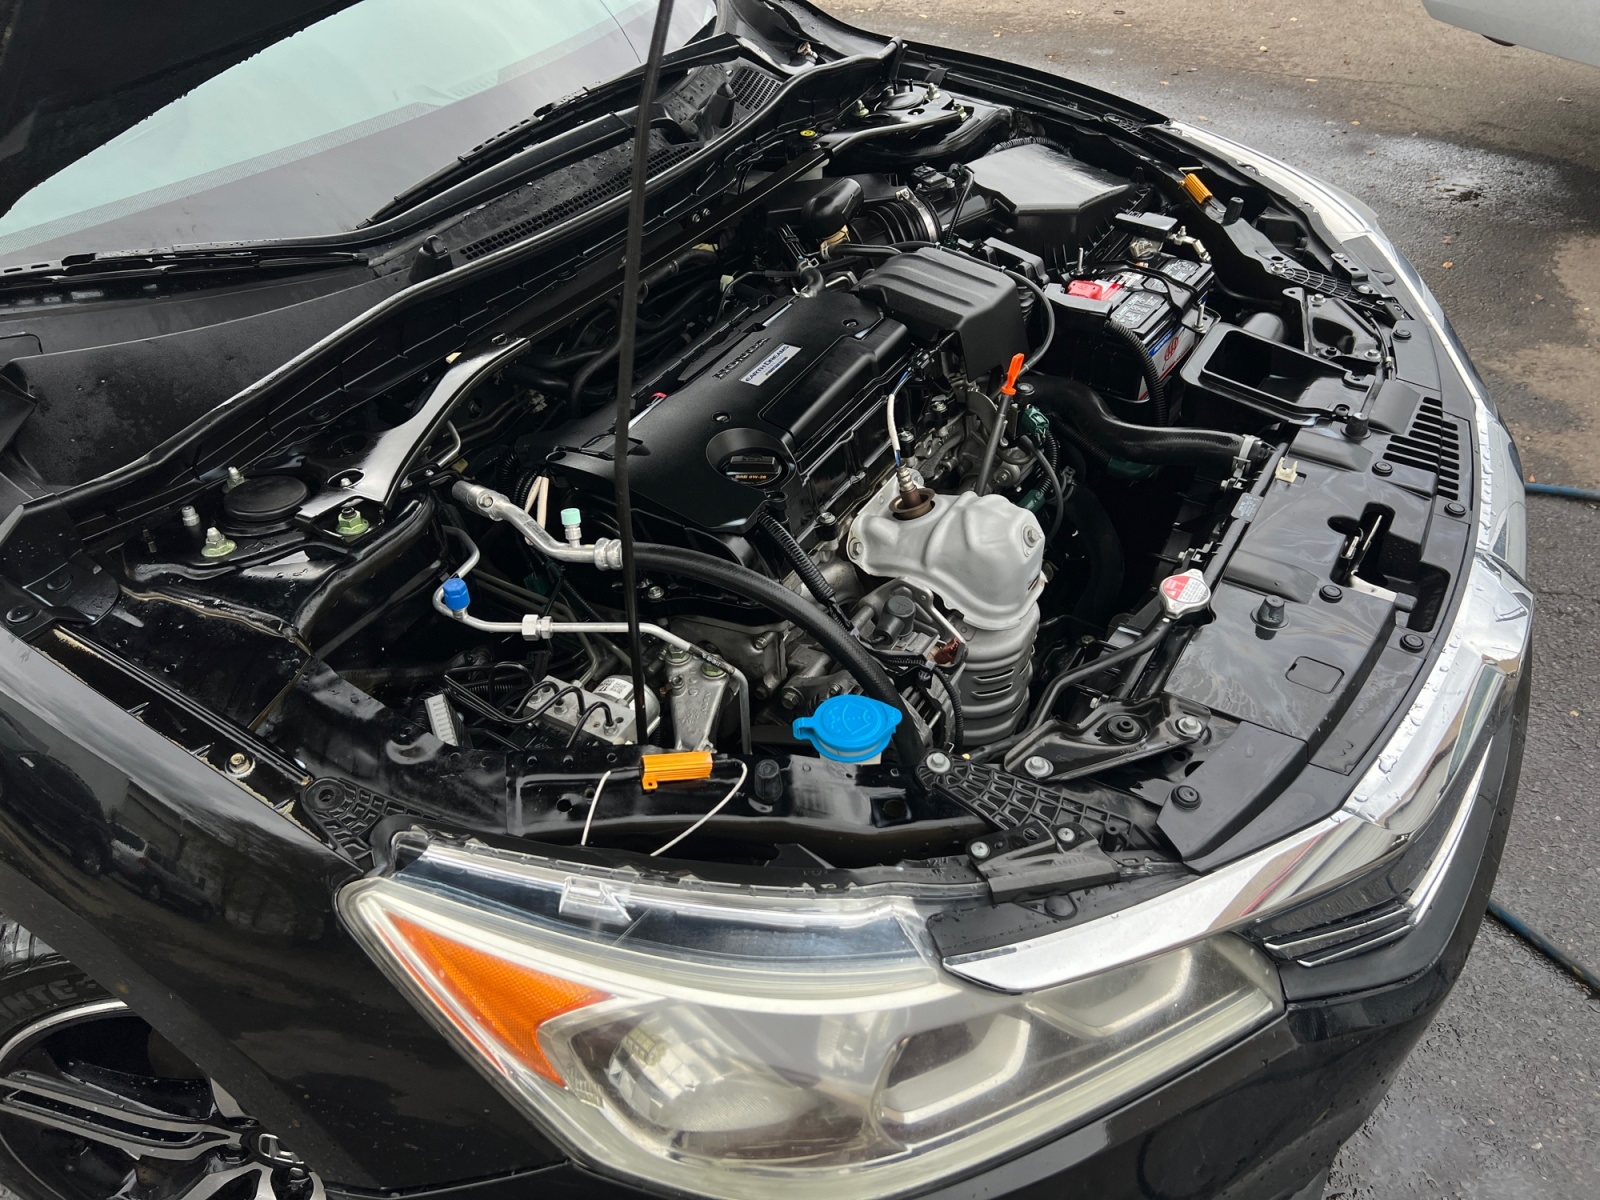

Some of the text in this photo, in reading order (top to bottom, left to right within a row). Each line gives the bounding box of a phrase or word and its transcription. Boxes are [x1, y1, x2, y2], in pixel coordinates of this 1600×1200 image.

[712, 337, 771, 380] HONDA
[745, 362, 767, 382] EARTH
[764, 345, 790, 367] DREAMS
